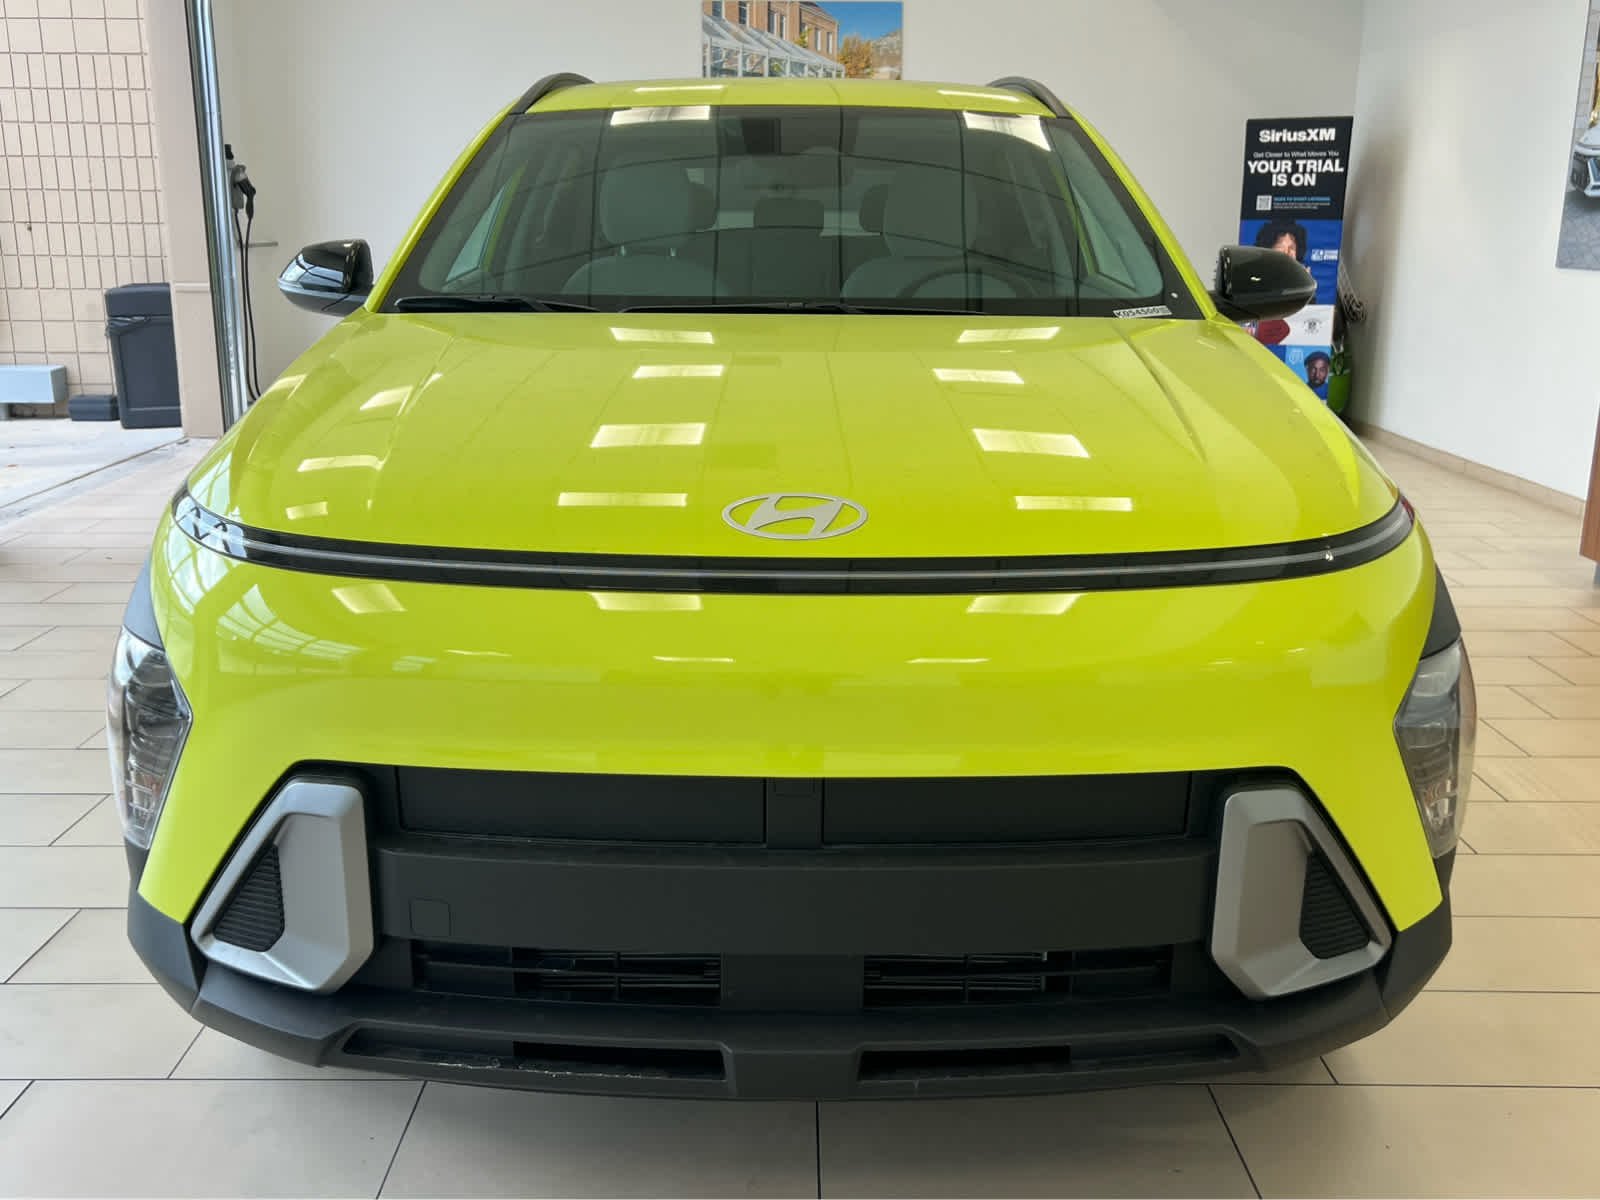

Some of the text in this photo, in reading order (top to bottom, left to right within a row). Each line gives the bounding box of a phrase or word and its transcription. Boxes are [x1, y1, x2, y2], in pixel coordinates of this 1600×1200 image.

[1259, 128, 1336, 142] SiriusXM
[1248, 159, 1344, 173] YOUR TRIAL
[1272, 173, 1316, 186] IS ON
